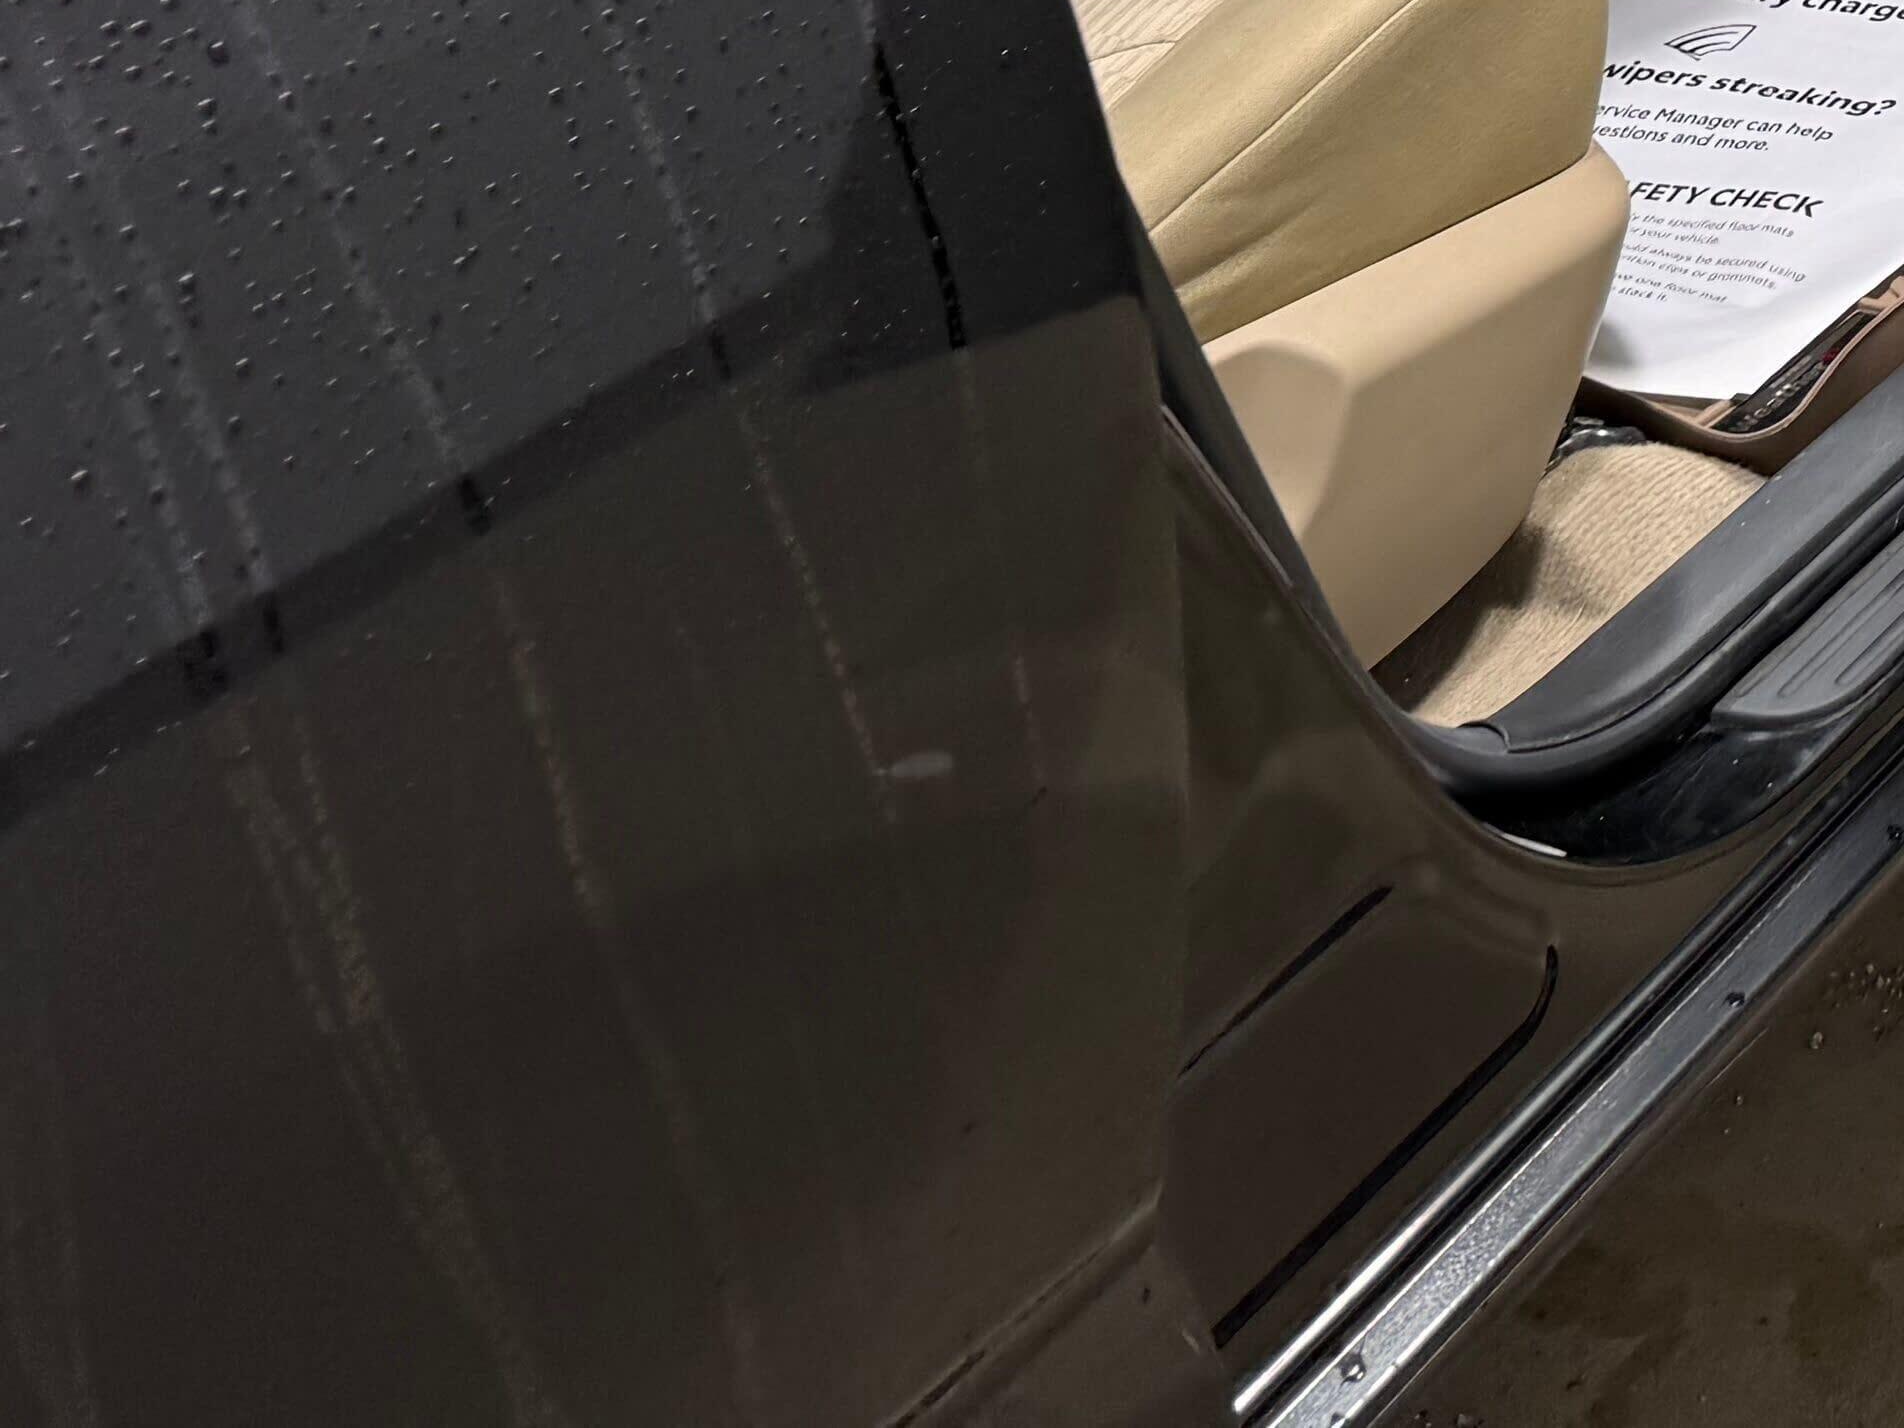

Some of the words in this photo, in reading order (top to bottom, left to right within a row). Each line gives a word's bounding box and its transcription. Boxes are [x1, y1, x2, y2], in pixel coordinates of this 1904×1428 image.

[1709, 75, 1897, 117] streaking?
[1653, 107, 1745, 131] Manager
[1745, 118, 1783, 134] can
[1784, 121, 1835, 142] help
[1671, 132, 1714, 147] and
[1713, 139, 1770, 152] more.
[1630, 181, 1711, 205] FETY
[1709, 188, 1825, 218] CHECK
[1727, 220, 1761, 233] floor
[1760, 223, 1795, 238] mats
[1714, 257, 1769, 271] secured
[1768, 264, 1808, 283] using
